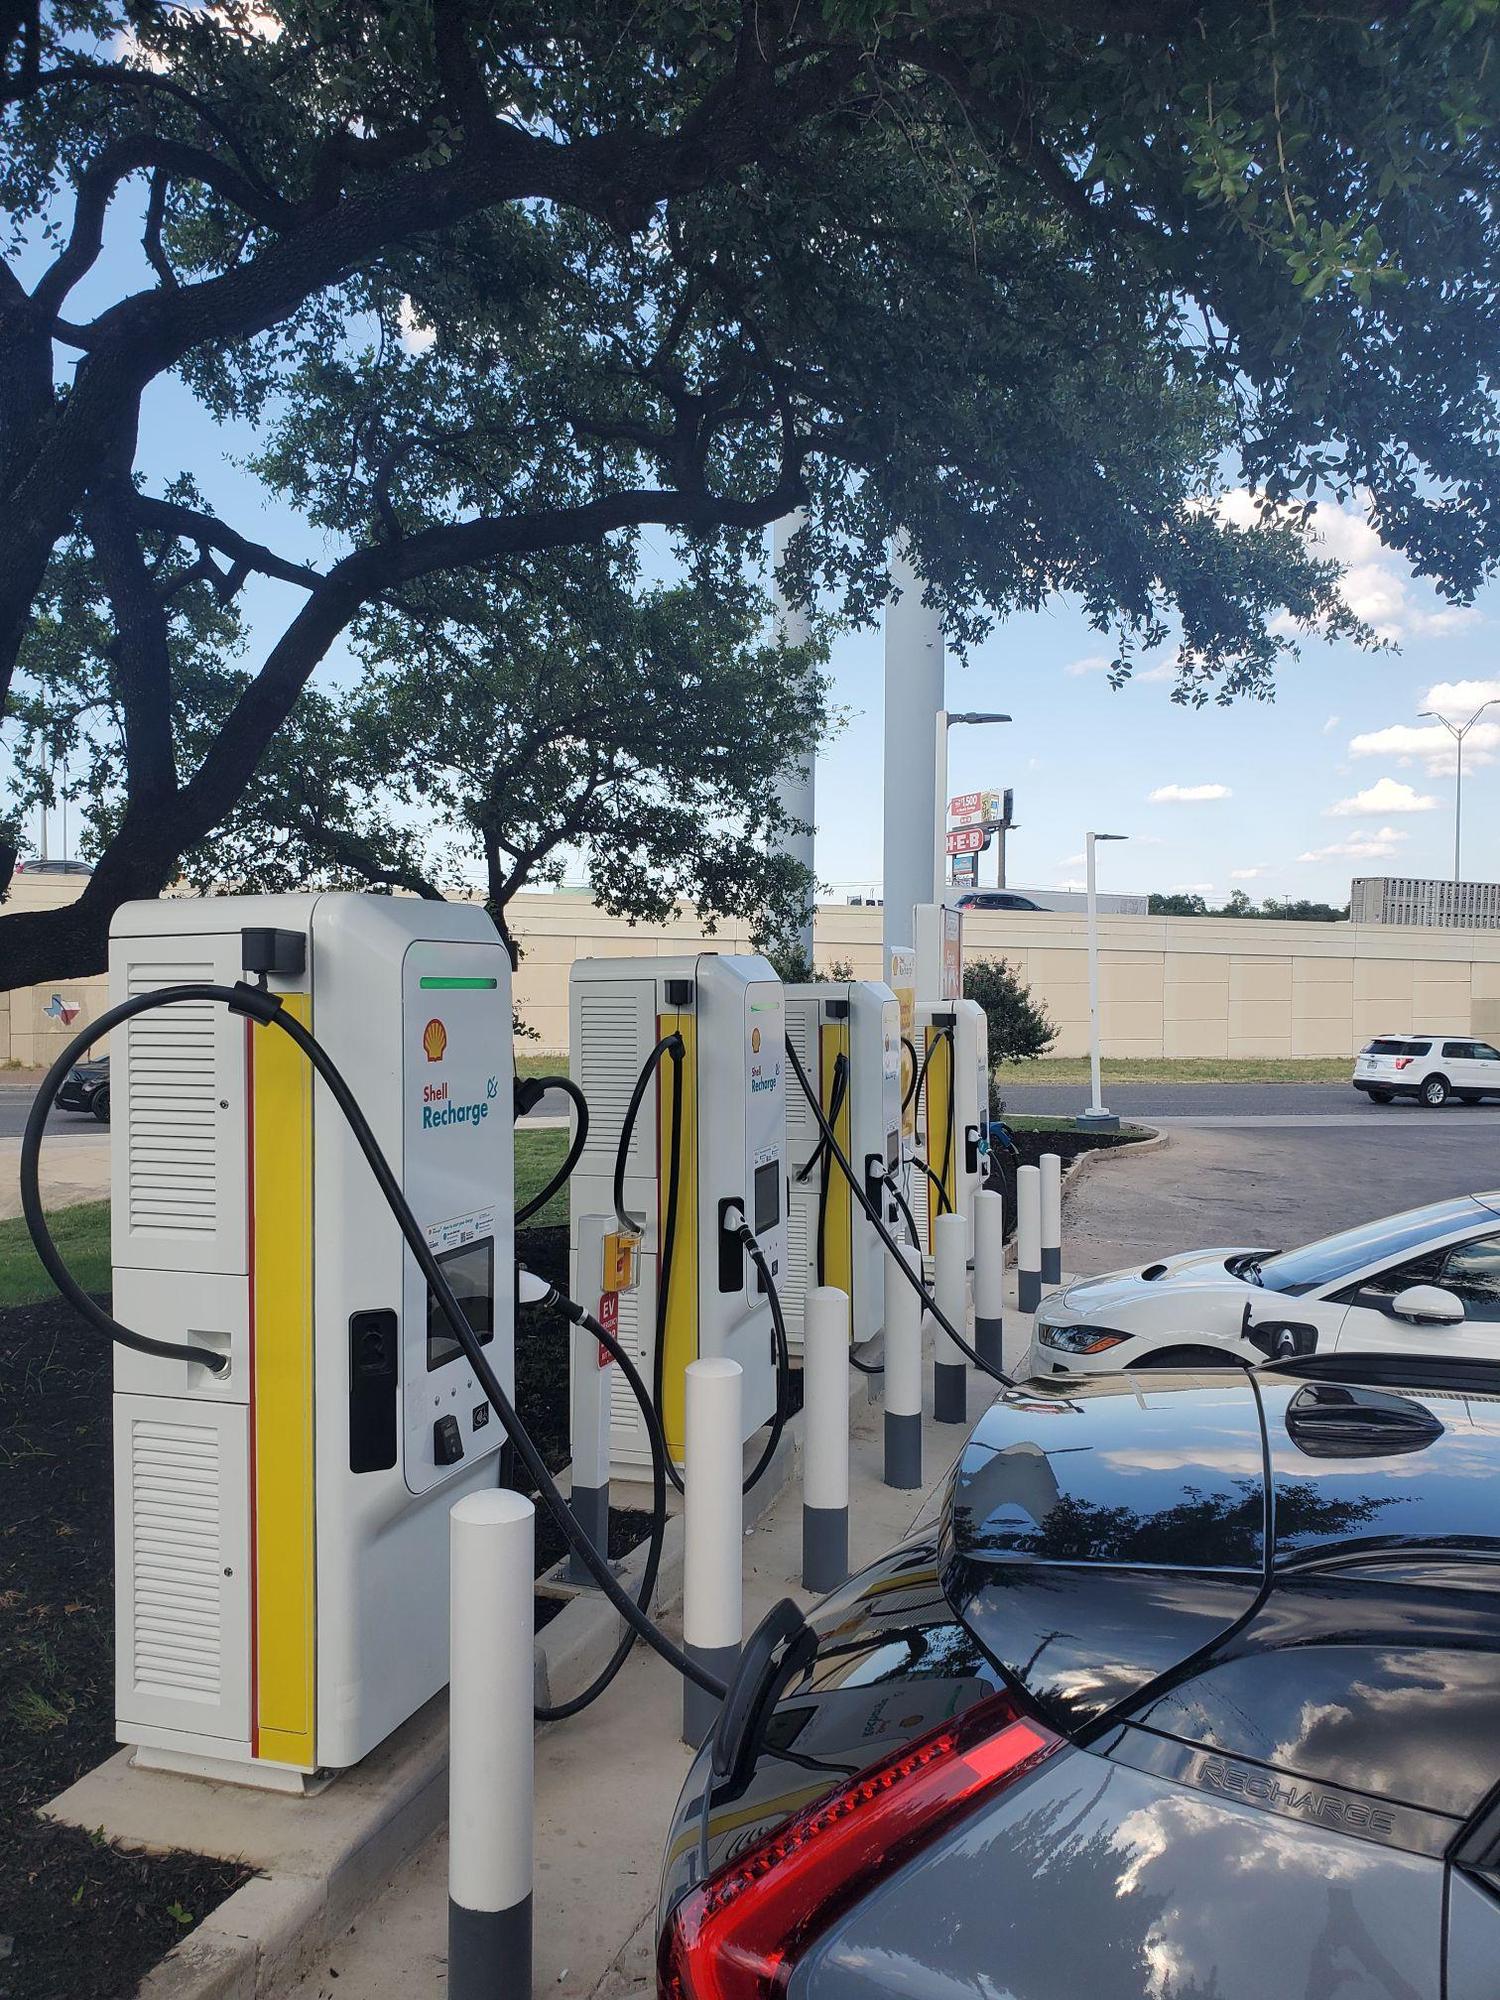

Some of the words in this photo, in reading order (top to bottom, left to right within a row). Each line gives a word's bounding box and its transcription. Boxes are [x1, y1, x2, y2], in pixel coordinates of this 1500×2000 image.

[423, 1082, 448, 1102] Shell
[752, 1076, 776, 1093] Recharge
[423, 1100, 488, 1129] Recharge
[603, 1299, 615, 1318] EV
[1199, 1760, 1395, 1835] RECHARGE
